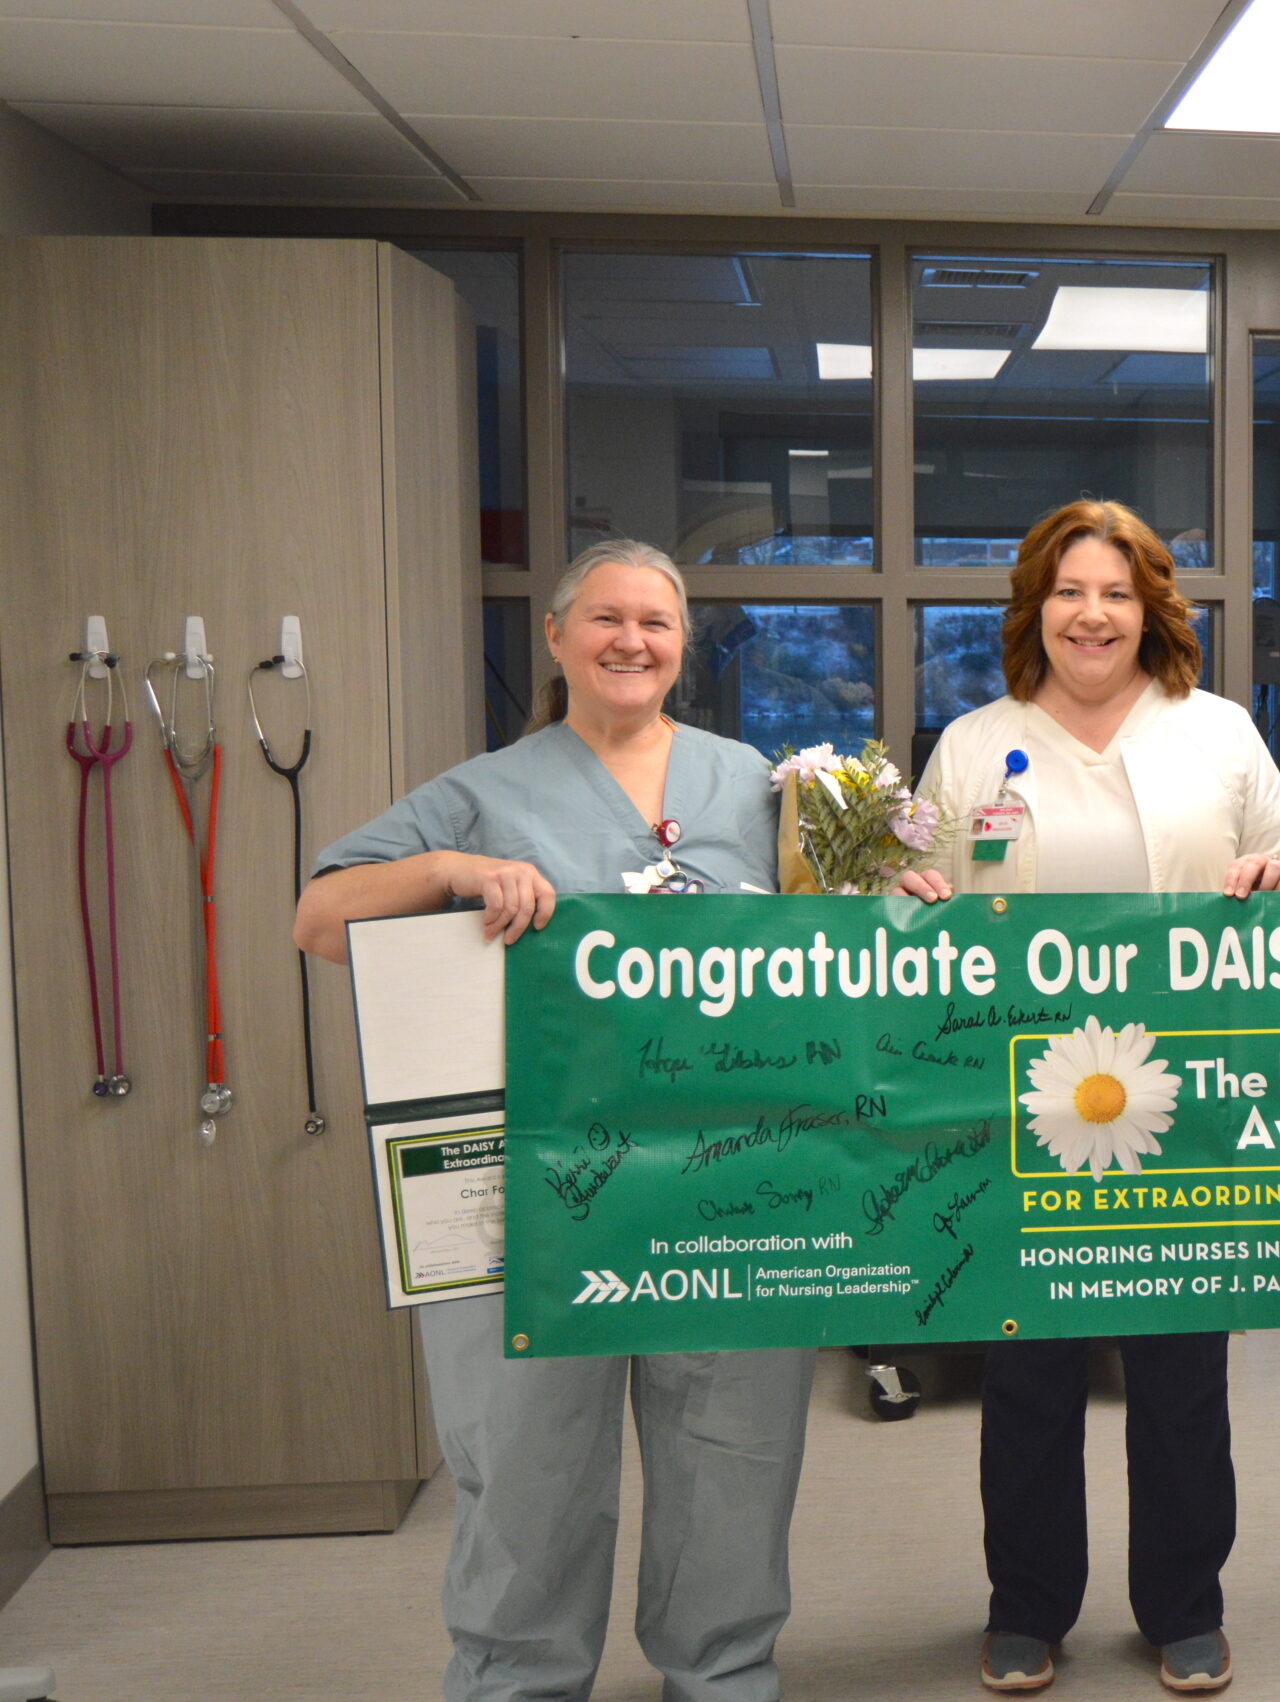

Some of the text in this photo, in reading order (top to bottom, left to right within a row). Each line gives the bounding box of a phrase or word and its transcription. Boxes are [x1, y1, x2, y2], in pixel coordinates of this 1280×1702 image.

[575, 927, 996, 1017] Congratulate
[1027, 929, 1138, 995] Our
[1054, 1002, 1073, 1022] RN
[806, 1038, 841, 1066] RN
[964, 1055, 985, 1070] RN
[1186, 1058, 1267, 1099] The
[681, 1116, 778, 1174] Amanda
[855, 1094, 887, 1122] RN
[441, 1146, 460, 1156] The
[463, 1141, 495, 1154] DAISY
[461, 1188, 489, 1199] Char
[819, 1176, 841, 1195] RN
[1024, 1190, 1081, 1211] FOR
[651, 1232, 852, 1254] In collaboration with
[1021, 1245, 1152, 1266] HONORING
[1161, 1242, 1249, 1261] NURSES
[756, 1264, 911, 1280] American Organization
[631, 1268, 742, 1301] AONL
[756, 1285, 775, 1297] for
[779, 1283, 832, 1297] Nursing
[1051, 1282, 1072, 1299] IN
[1082, 1278, 1183, 1298] MEMORY
[1192, 1276, 1221, 1294] OF
[1229, 1275, 1246, 1292] J.
